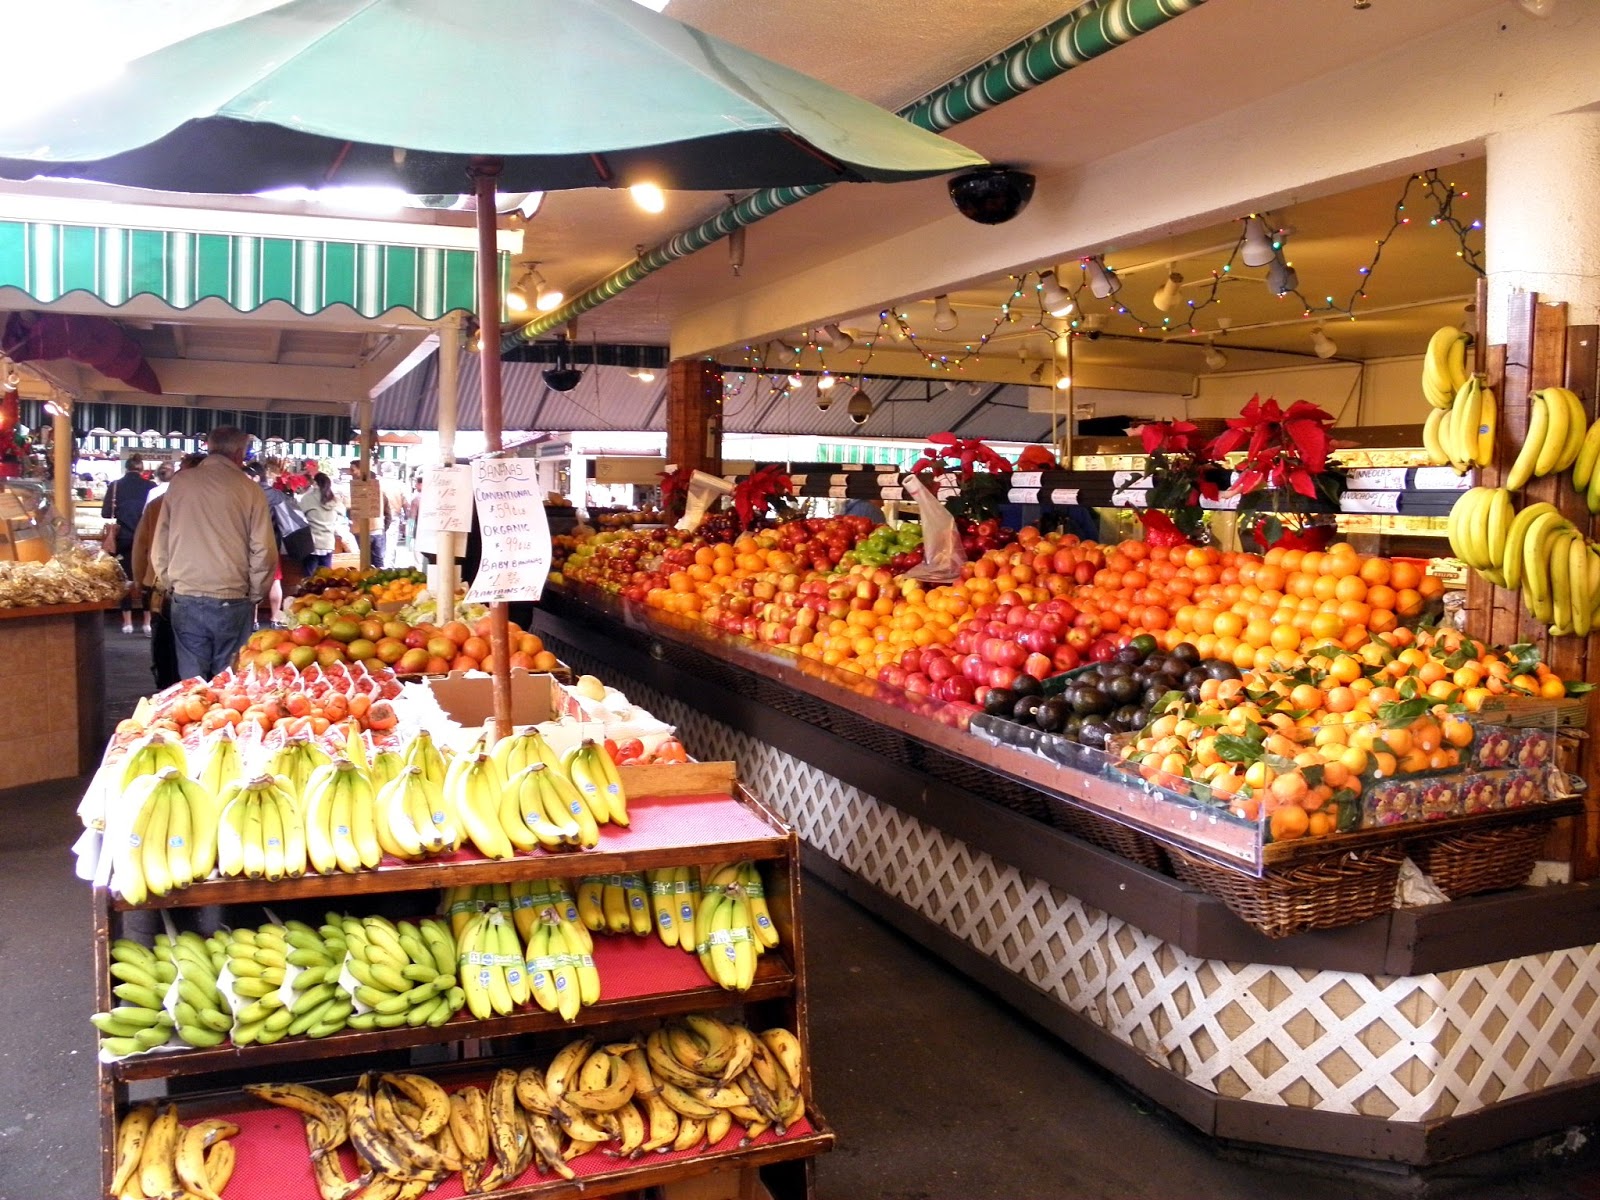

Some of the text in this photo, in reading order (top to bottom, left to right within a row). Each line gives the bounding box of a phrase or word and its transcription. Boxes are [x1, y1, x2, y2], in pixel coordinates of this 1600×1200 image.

[478, 460, 523, 479] BANANAS
[476, 488, 533, 502] CONVENTIONAL
[483, 523, 530, 537] ORGANIC
[481, 558, 509, 572] BABY
